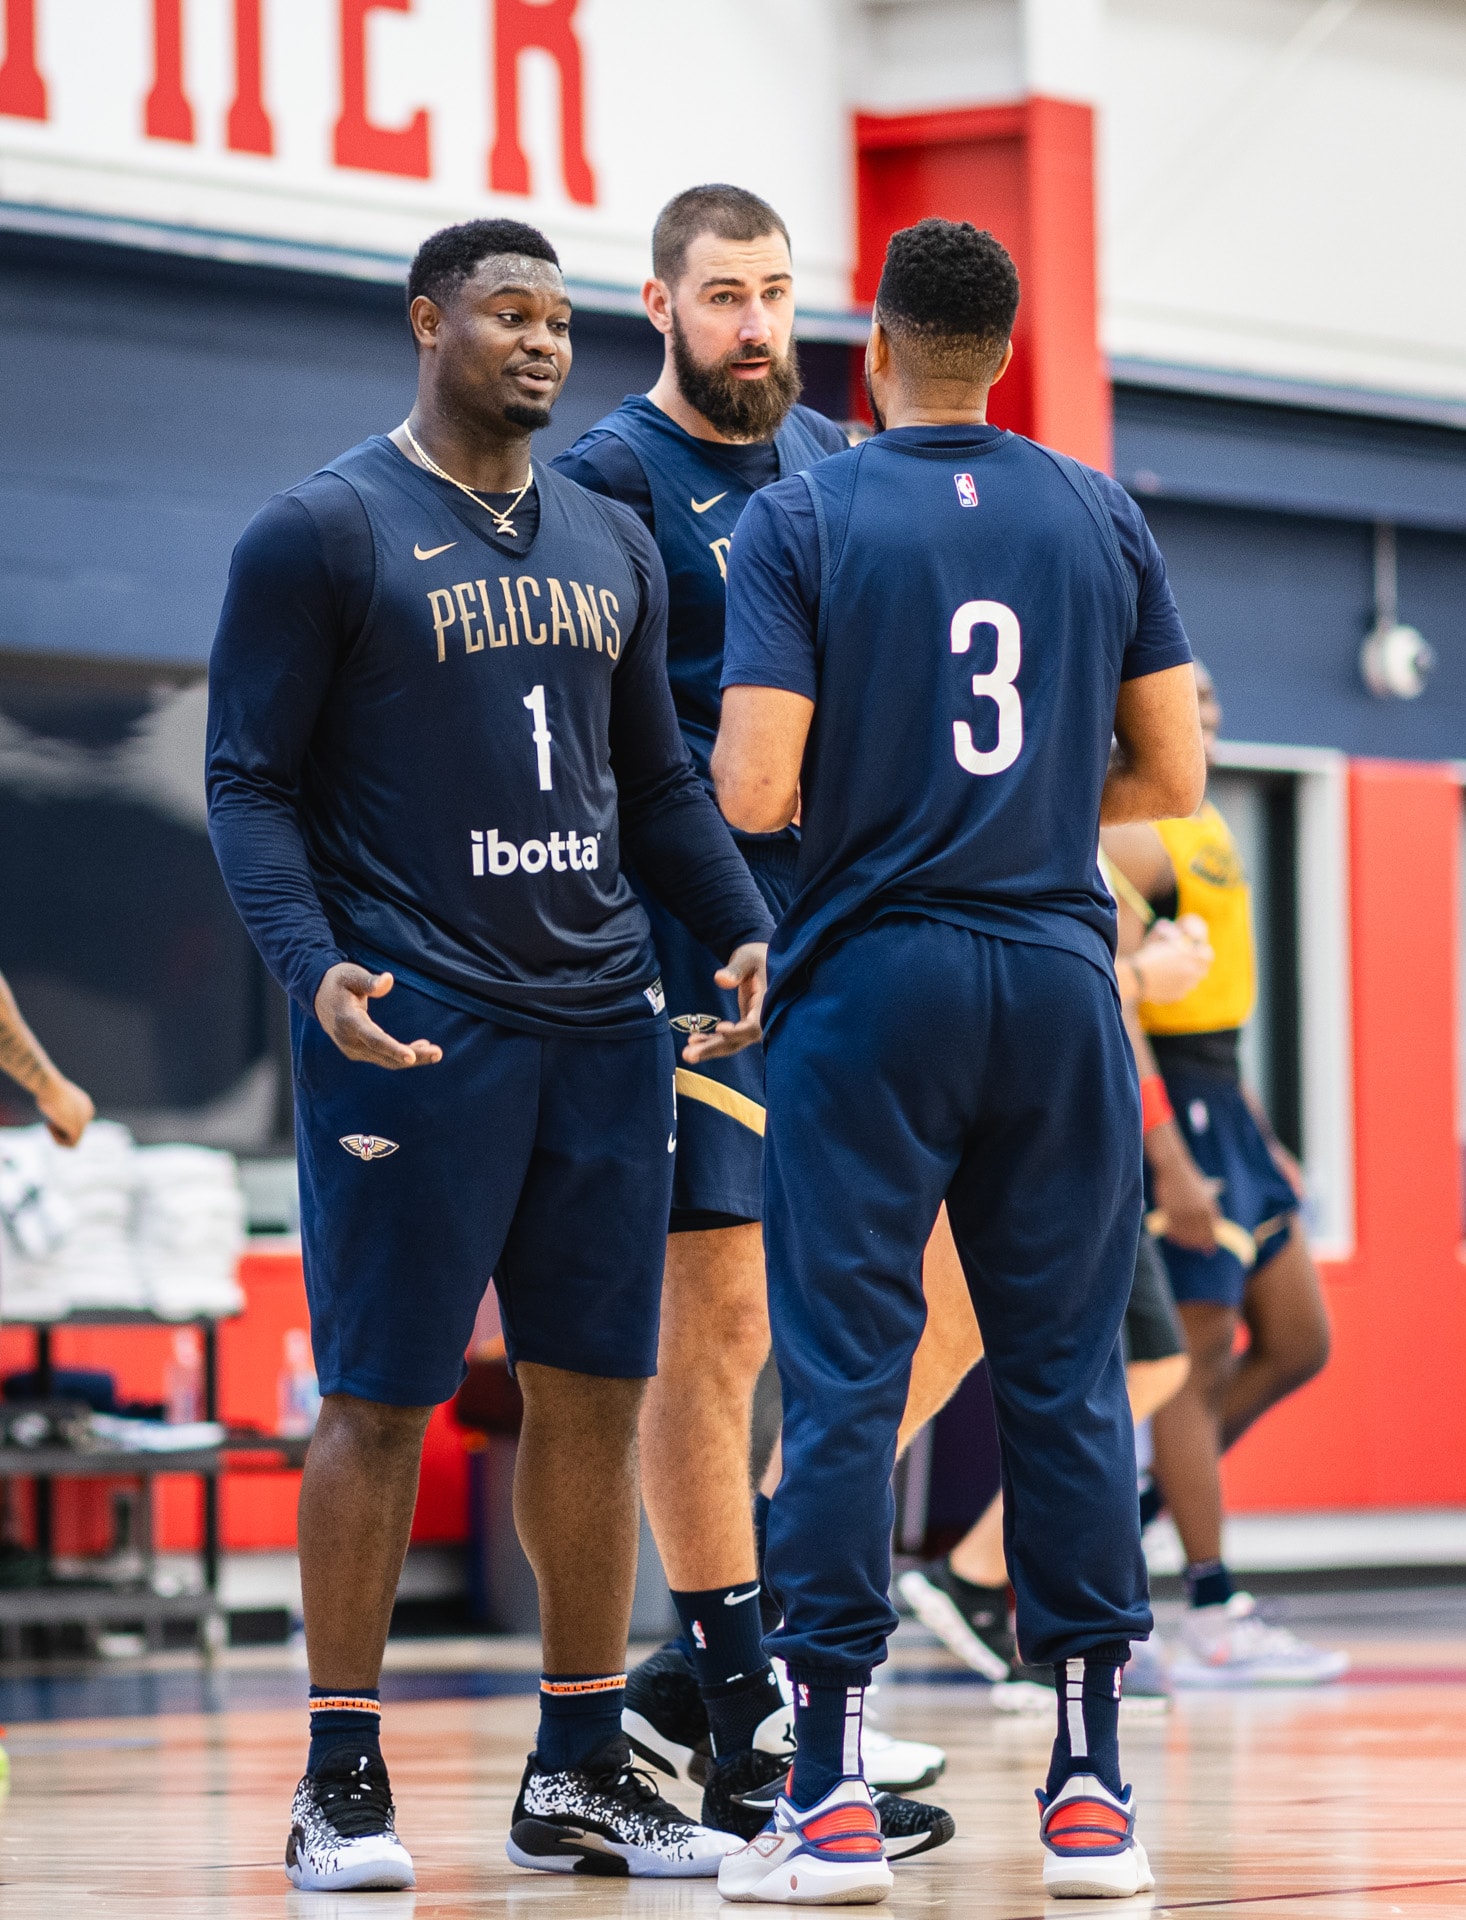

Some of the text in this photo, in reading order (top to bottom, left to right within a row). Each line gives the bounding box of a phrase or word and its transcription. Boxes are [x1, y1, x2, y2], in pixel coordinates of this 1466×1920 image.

[427, 575, 621, 662] PELICANS
[950, 600, 1024, 776] 3
[522, 684, 553, 791] 1
[470, 828, 600, 876] ibotta
